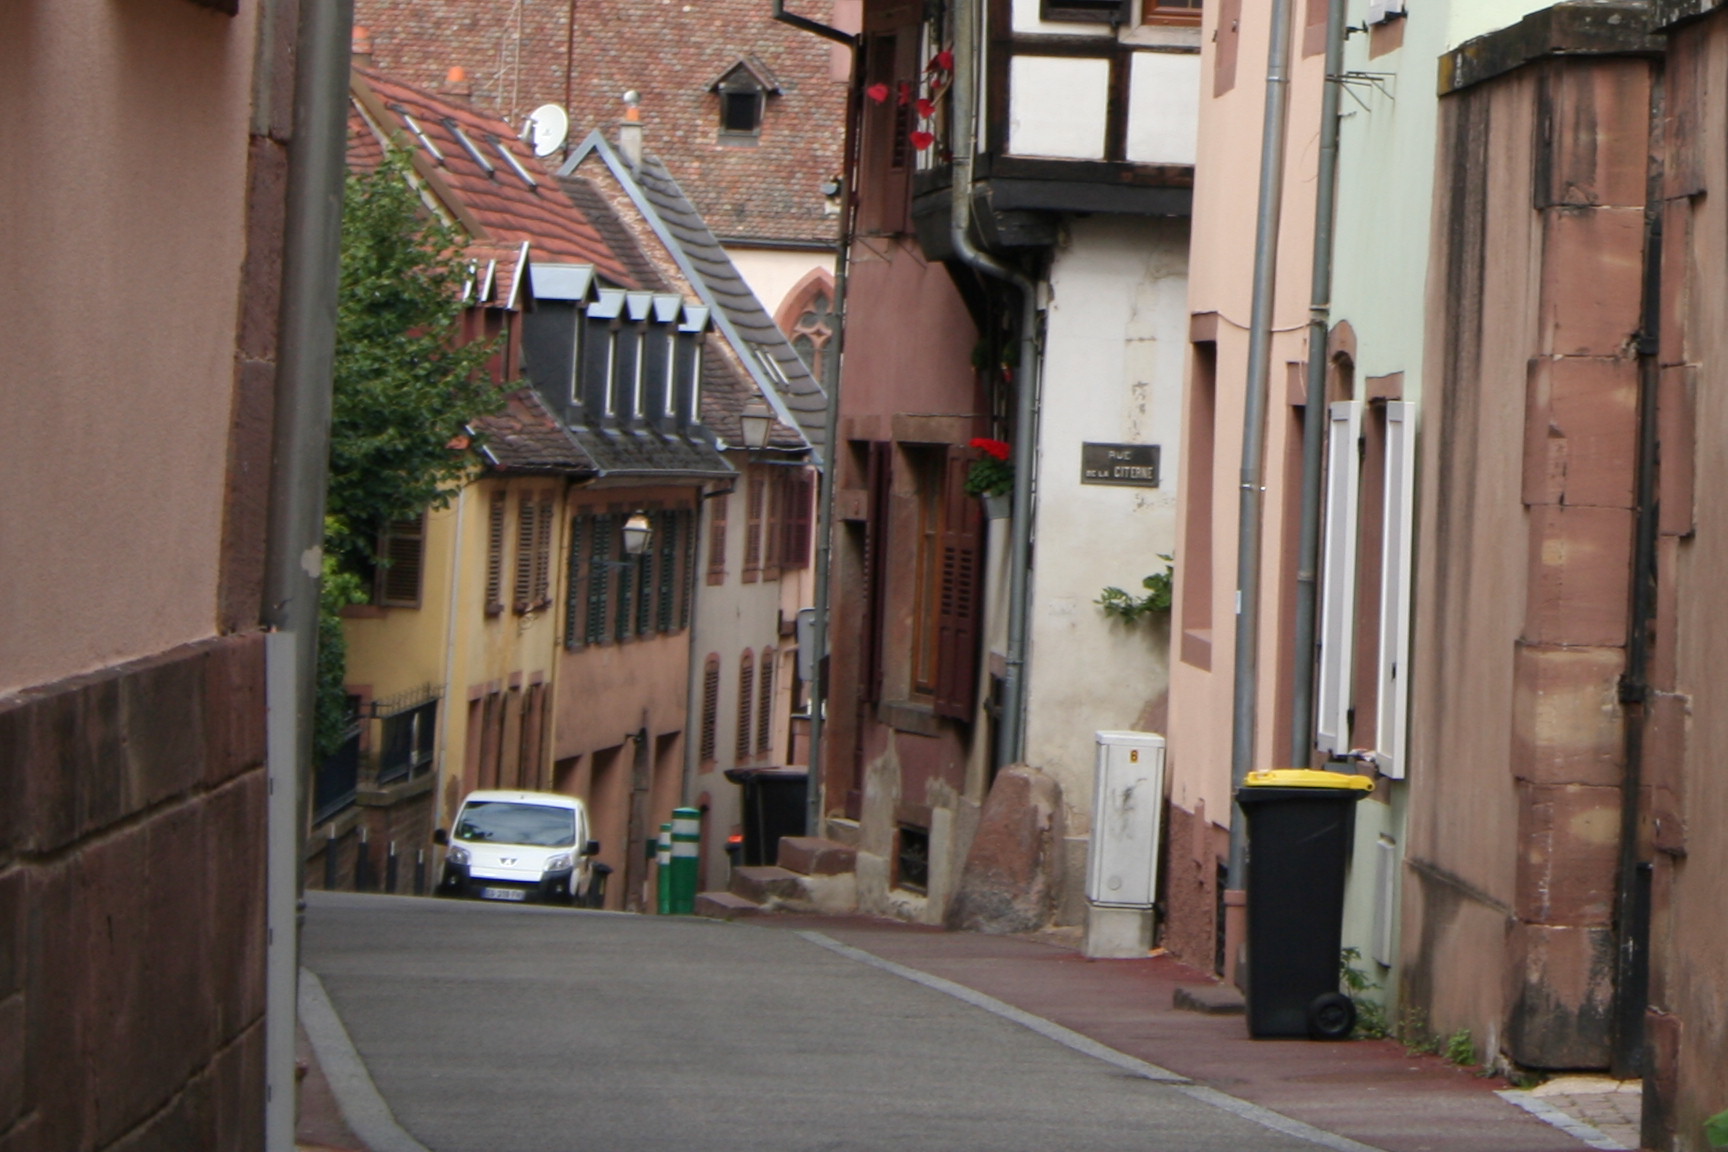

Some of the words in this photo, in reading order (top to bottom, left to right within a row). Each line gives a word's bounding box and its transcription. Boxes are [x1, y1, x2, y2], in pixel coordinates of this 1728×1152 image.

[1108, 450, 1131, 460] RUE
[1086, 469, 1096, 477] DE
[1114, 466, 1153, 479] CITERNE
